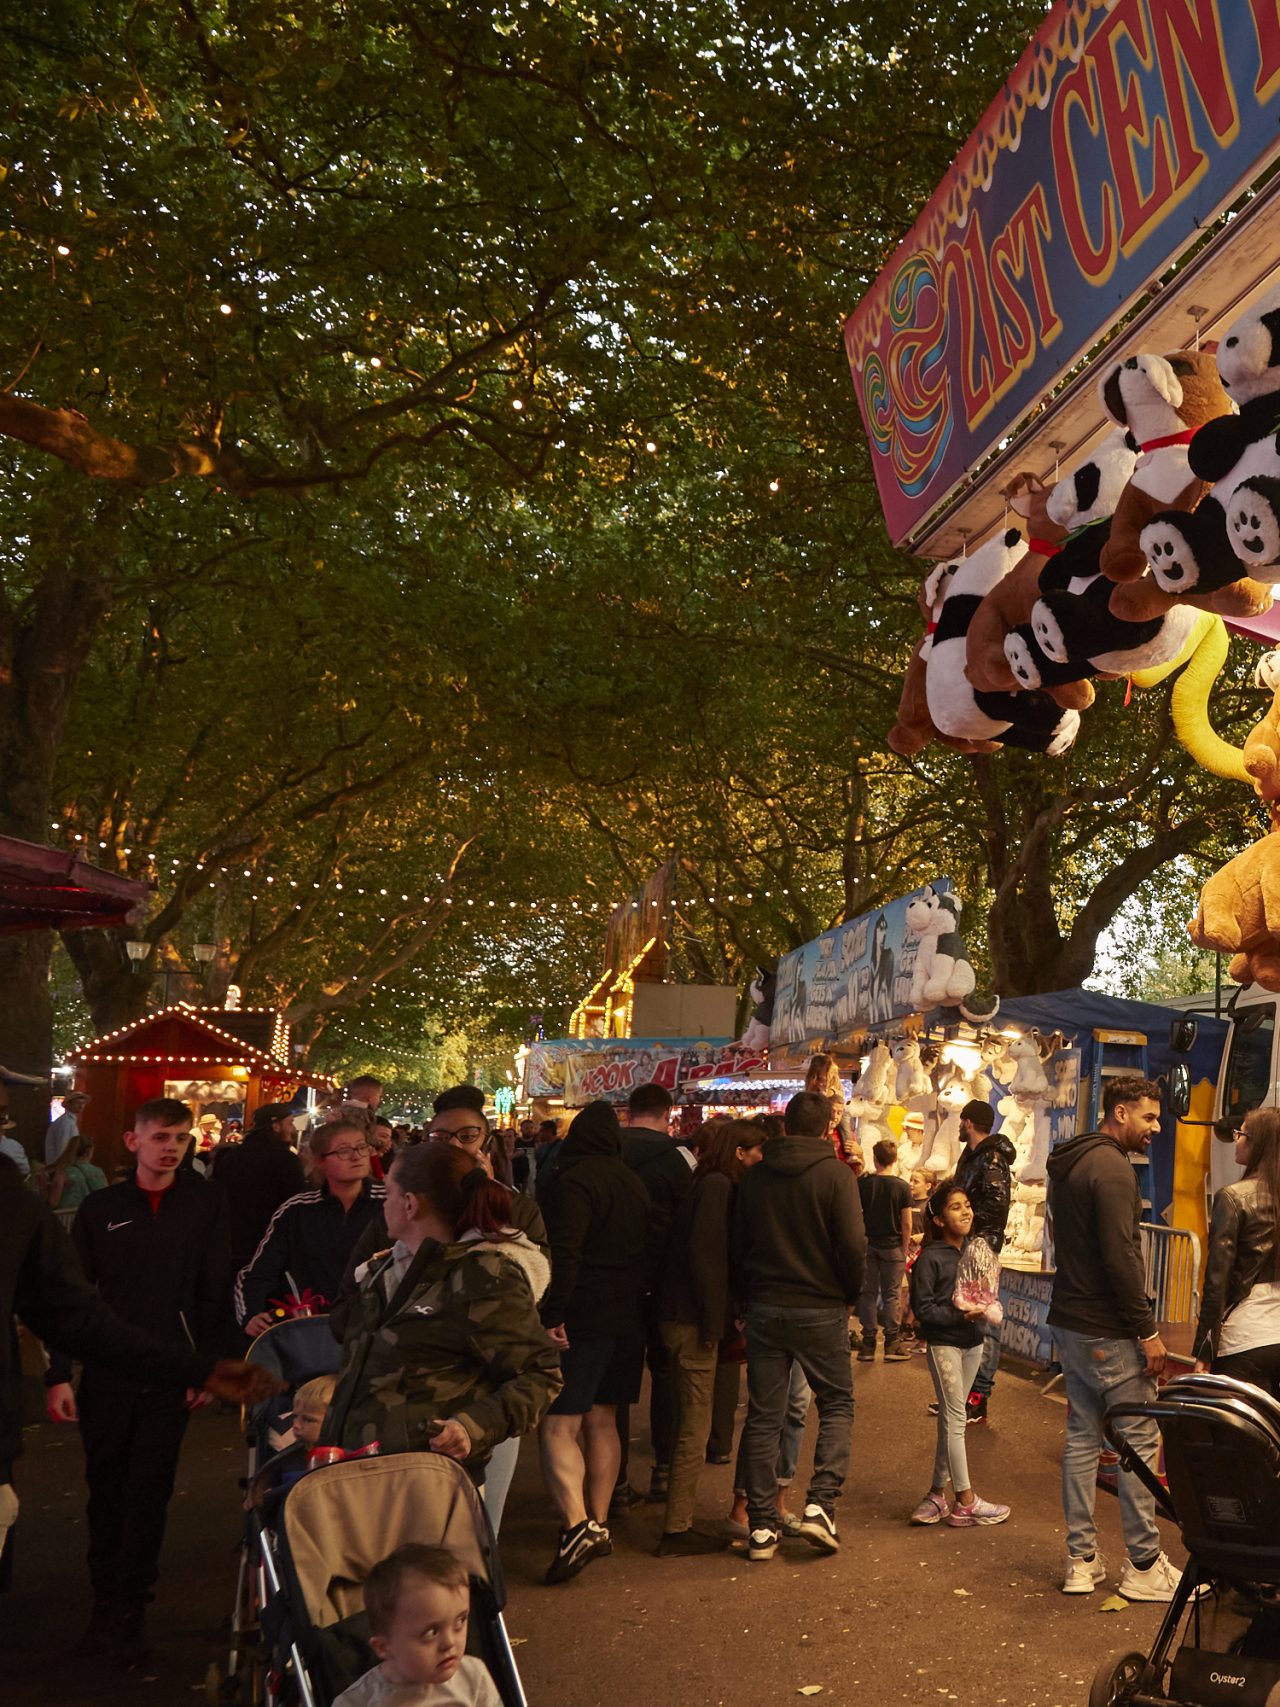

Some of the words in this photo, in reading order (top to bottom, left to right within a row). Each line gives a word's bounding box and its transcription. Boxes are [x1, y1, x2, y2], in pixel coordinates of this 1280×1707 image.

[580, 1060, 638, 1097] HOOK
[651, 1056, 681, 1091] A
[1008, 1297, 1031, 1323] GETS
[1030, 1306, 1039, 1327] A
[1000, 1319, 1041, 1361] HUSKY
[1209, 1671, 1246, 1687] Oyster2
